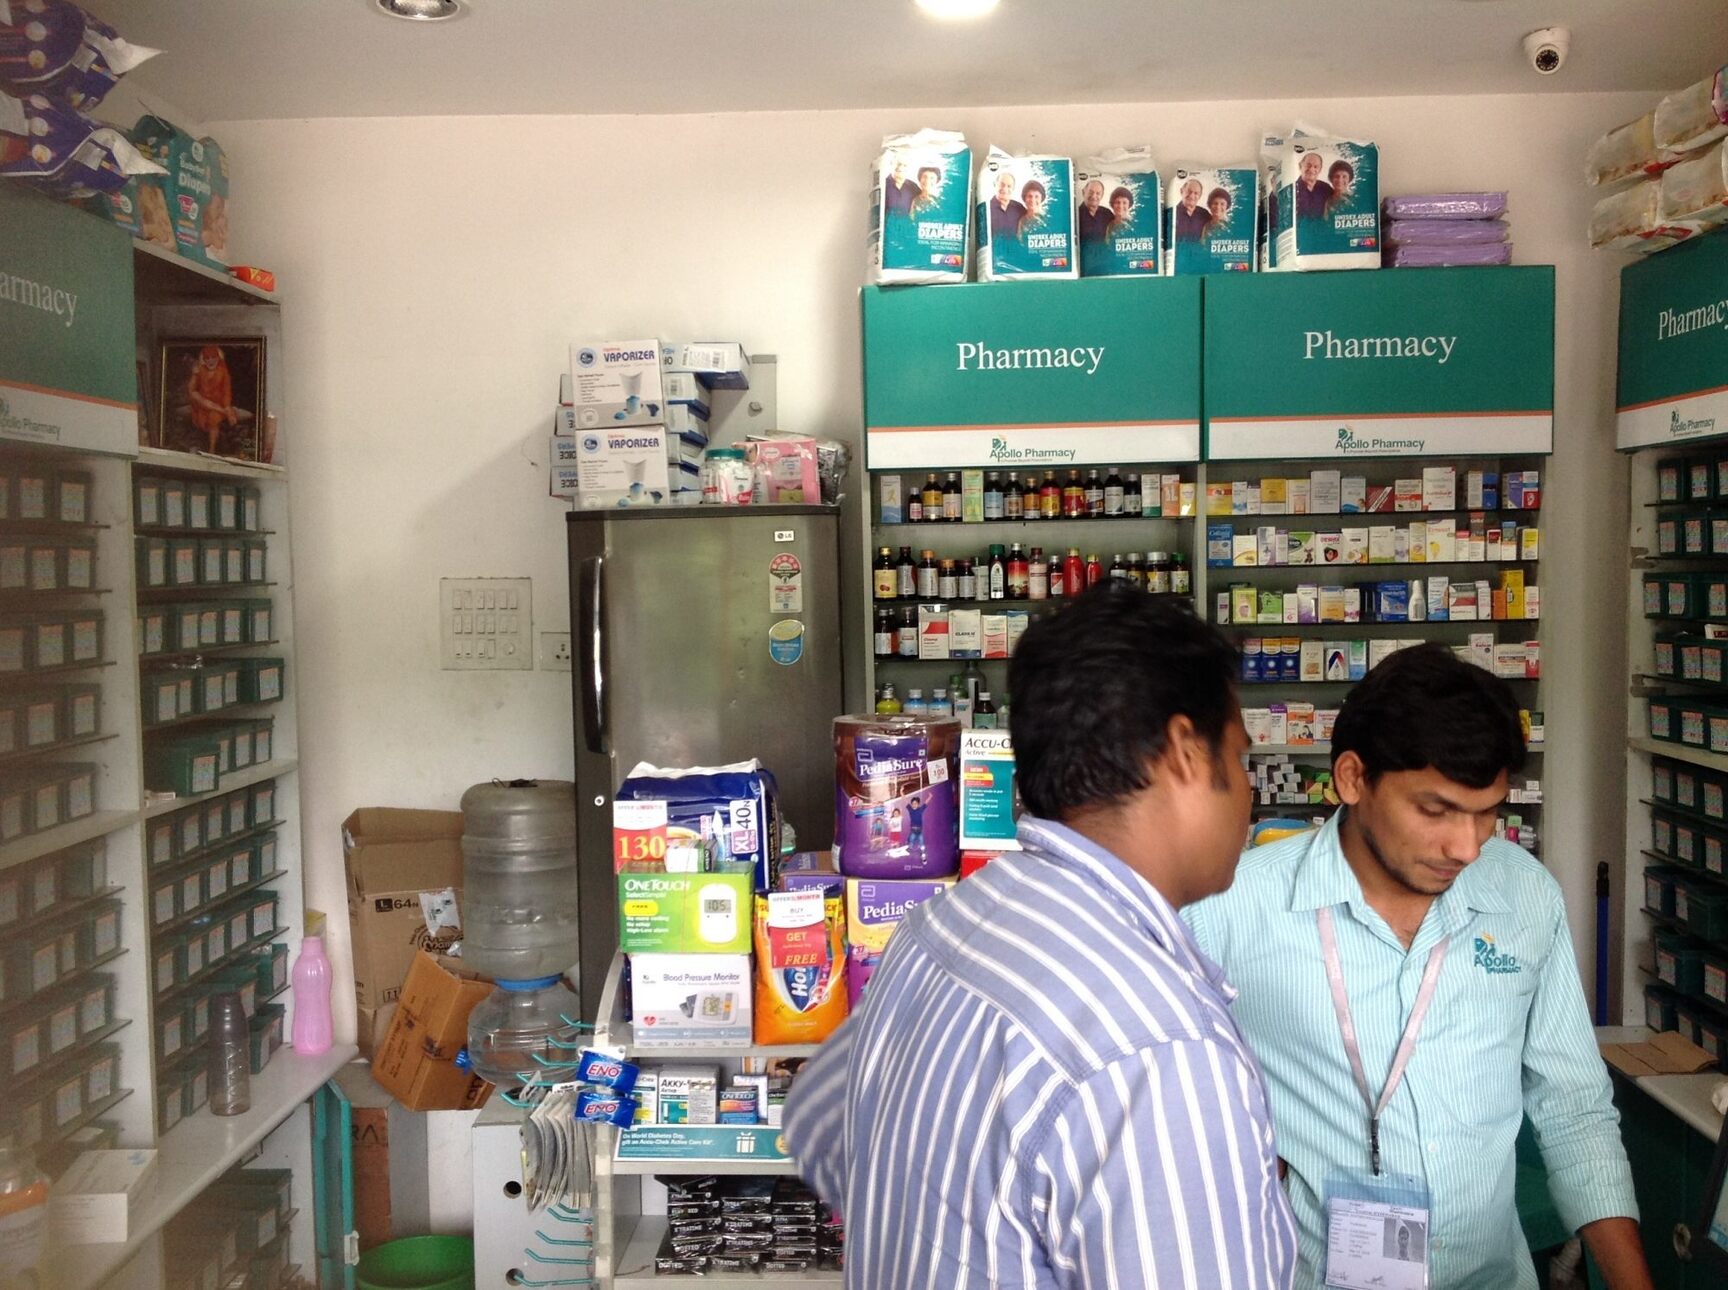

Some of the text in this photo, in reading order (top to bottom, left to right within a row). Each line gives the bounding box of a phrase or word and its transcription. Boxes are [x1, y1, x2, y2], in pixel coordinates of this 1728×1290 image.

[1335, 218, 1376, 229] DIAPERS
[918, 228, 964, 241] DIAPERS
[1028, 238, 1067, 249] DIAPERS
[1115, 242, 1154, 252] DIAPERS
[1211, 244, 1250, 253] DIAPERS
[1303, 330, 1457, 363] Pharmacy
[603, 350, 655, 363] VAPORIZER
[956, 341, 1105, 375] Pharmacy
[1687, 418, 1715, 431] Pharmacy
[608, 438, 660, 449] VAPORIZER
[1335, 437, 1425, 453] Apollo Pharmacy
[989, 448, 1022, 463] Apollo
[1025, 447, 1076, 461] Pharmacy
[860, 759, 923, 776] PediaSure
[734, 831, 749, 851] XL
[618, 836, 667, 860] 130
[863, 900, 917, 920] PediaS
[786, 931, 808, 943] GET
[785, 953, 818, 965] FREE
[1474, 954, 1516, 974] Apollo
[663, 973, 740, 982] Blood Pressure Monitor
[588, 1064, 621, 1078] ENO
[585, 1103, 618, 1114] ENO
